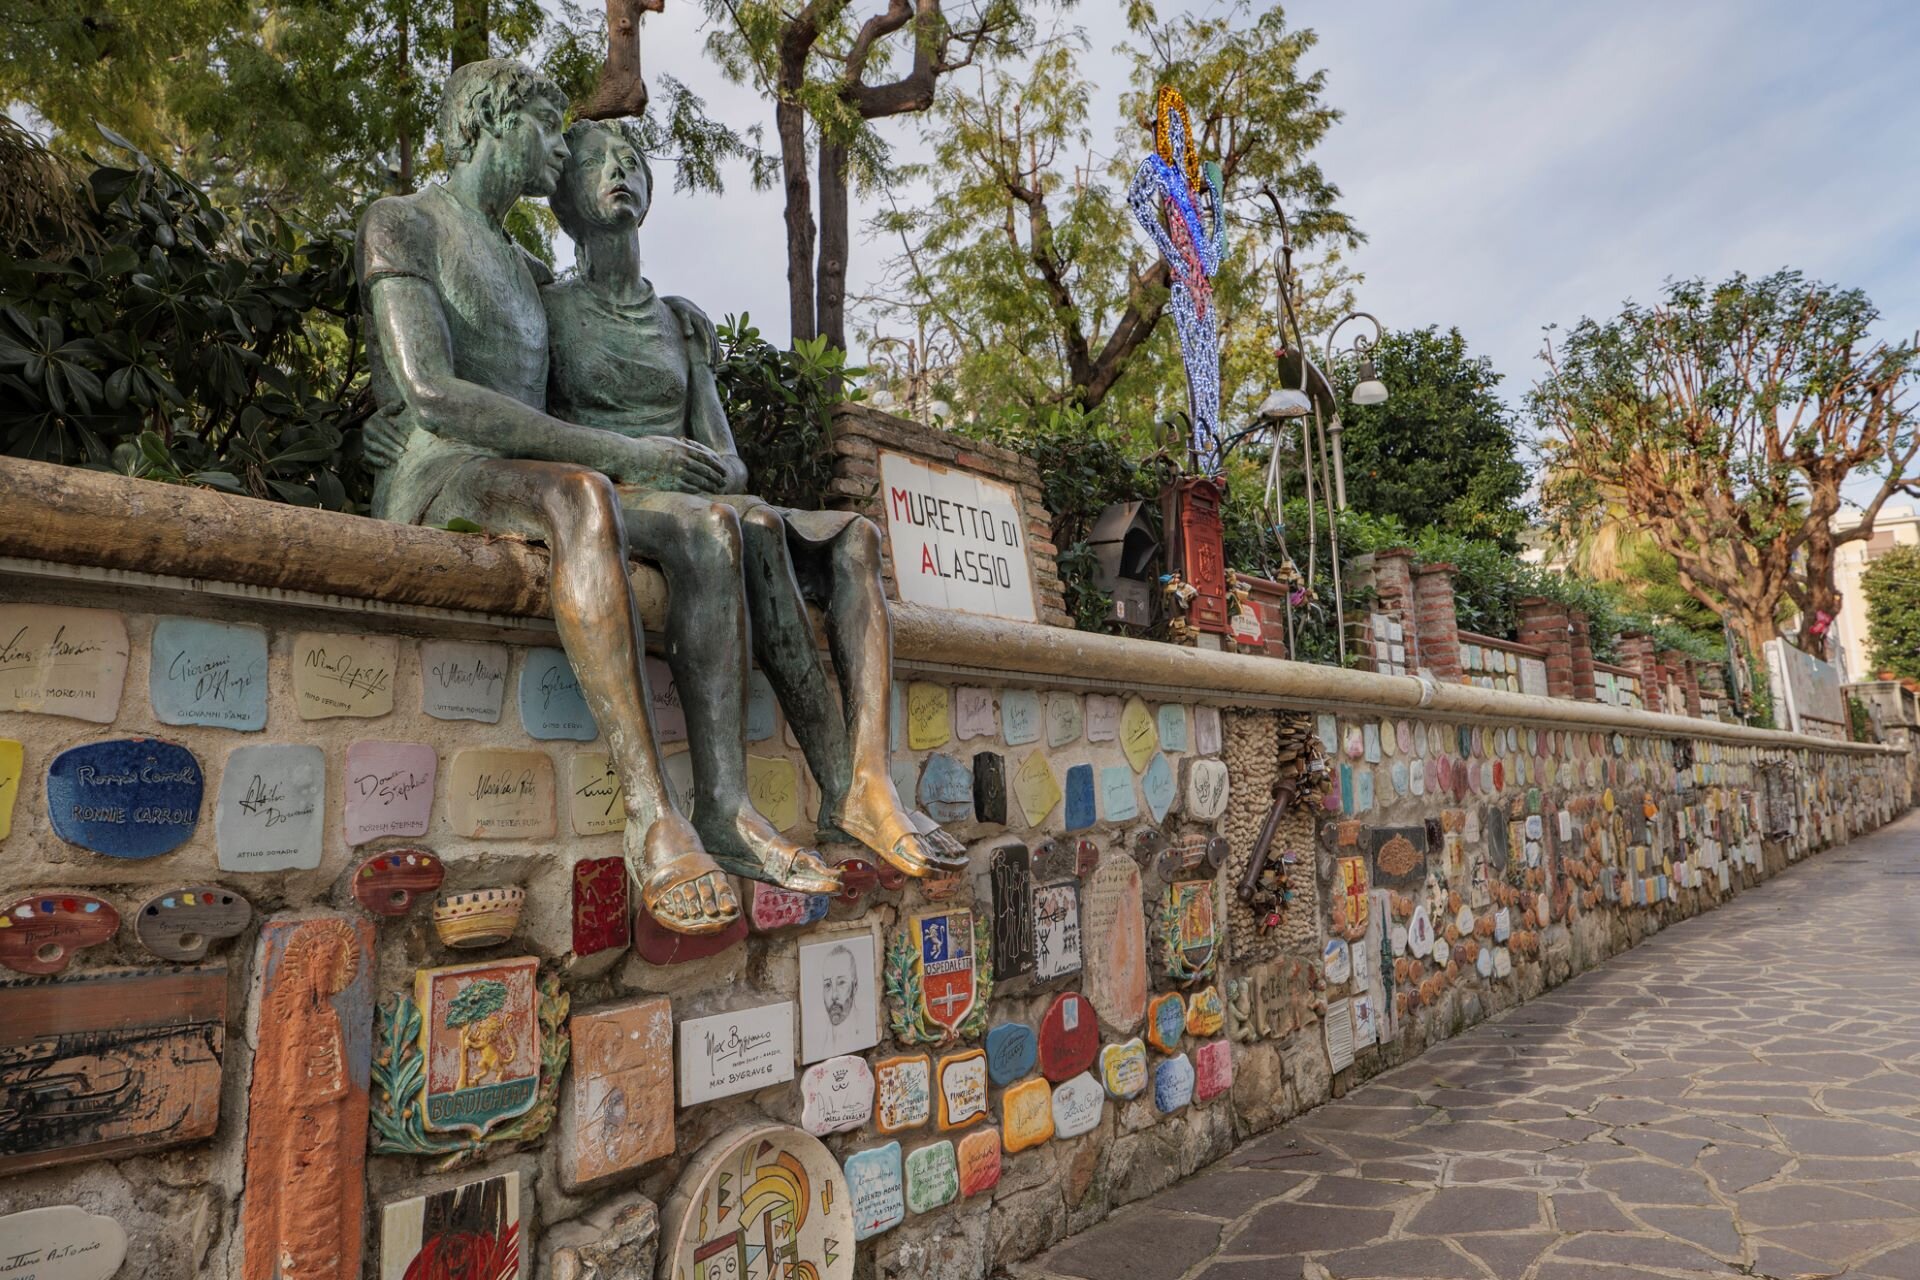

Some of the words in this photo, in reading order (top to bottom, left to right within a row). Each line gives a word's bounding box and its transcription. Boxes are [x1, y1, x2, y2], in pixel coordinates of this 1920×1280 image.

[891, 486, 996, 542] MURETTO
[1001, 520, 1019, 548] DI
[921, 542, 1011, 589] ALASSIO
[177, 710, 221, 719] GIOVANNI
[71, 804, 126, 824] RONNIE
[134, 806, 196, 826] CARROLL
[926, 957, 973, 975] OSPEDALETTI
[709, 1078, 725, 1089] MAX
[728, 1064, 773, 1084] BYGRAVES
[431, 1083, 530, 1121] BORDIGHERA
